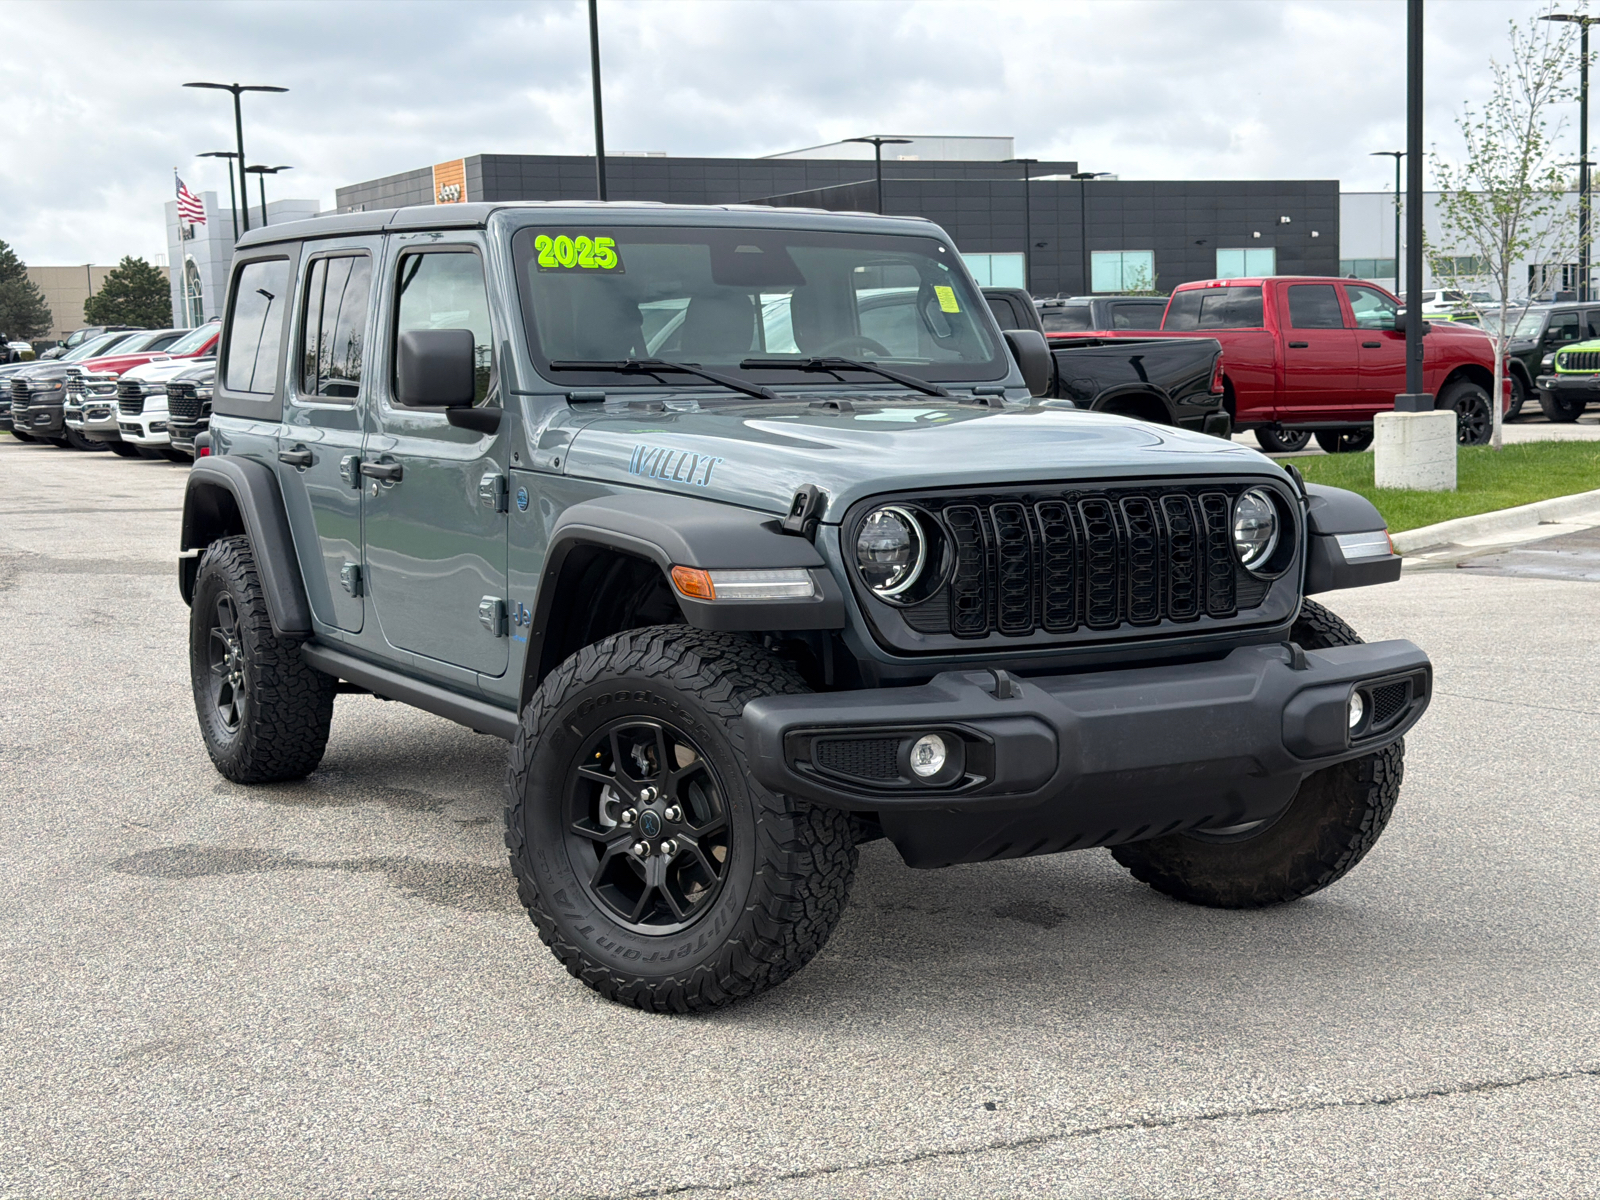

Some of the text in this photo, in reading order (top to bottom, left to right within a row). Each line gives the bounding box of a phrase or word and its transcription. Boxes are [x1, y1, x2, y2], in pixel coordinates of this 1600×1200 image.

[438, 182, 461, 202] Jeep
[534, 234, 618, 269] 2025
[628, 444, 724, 487] WILLYS
